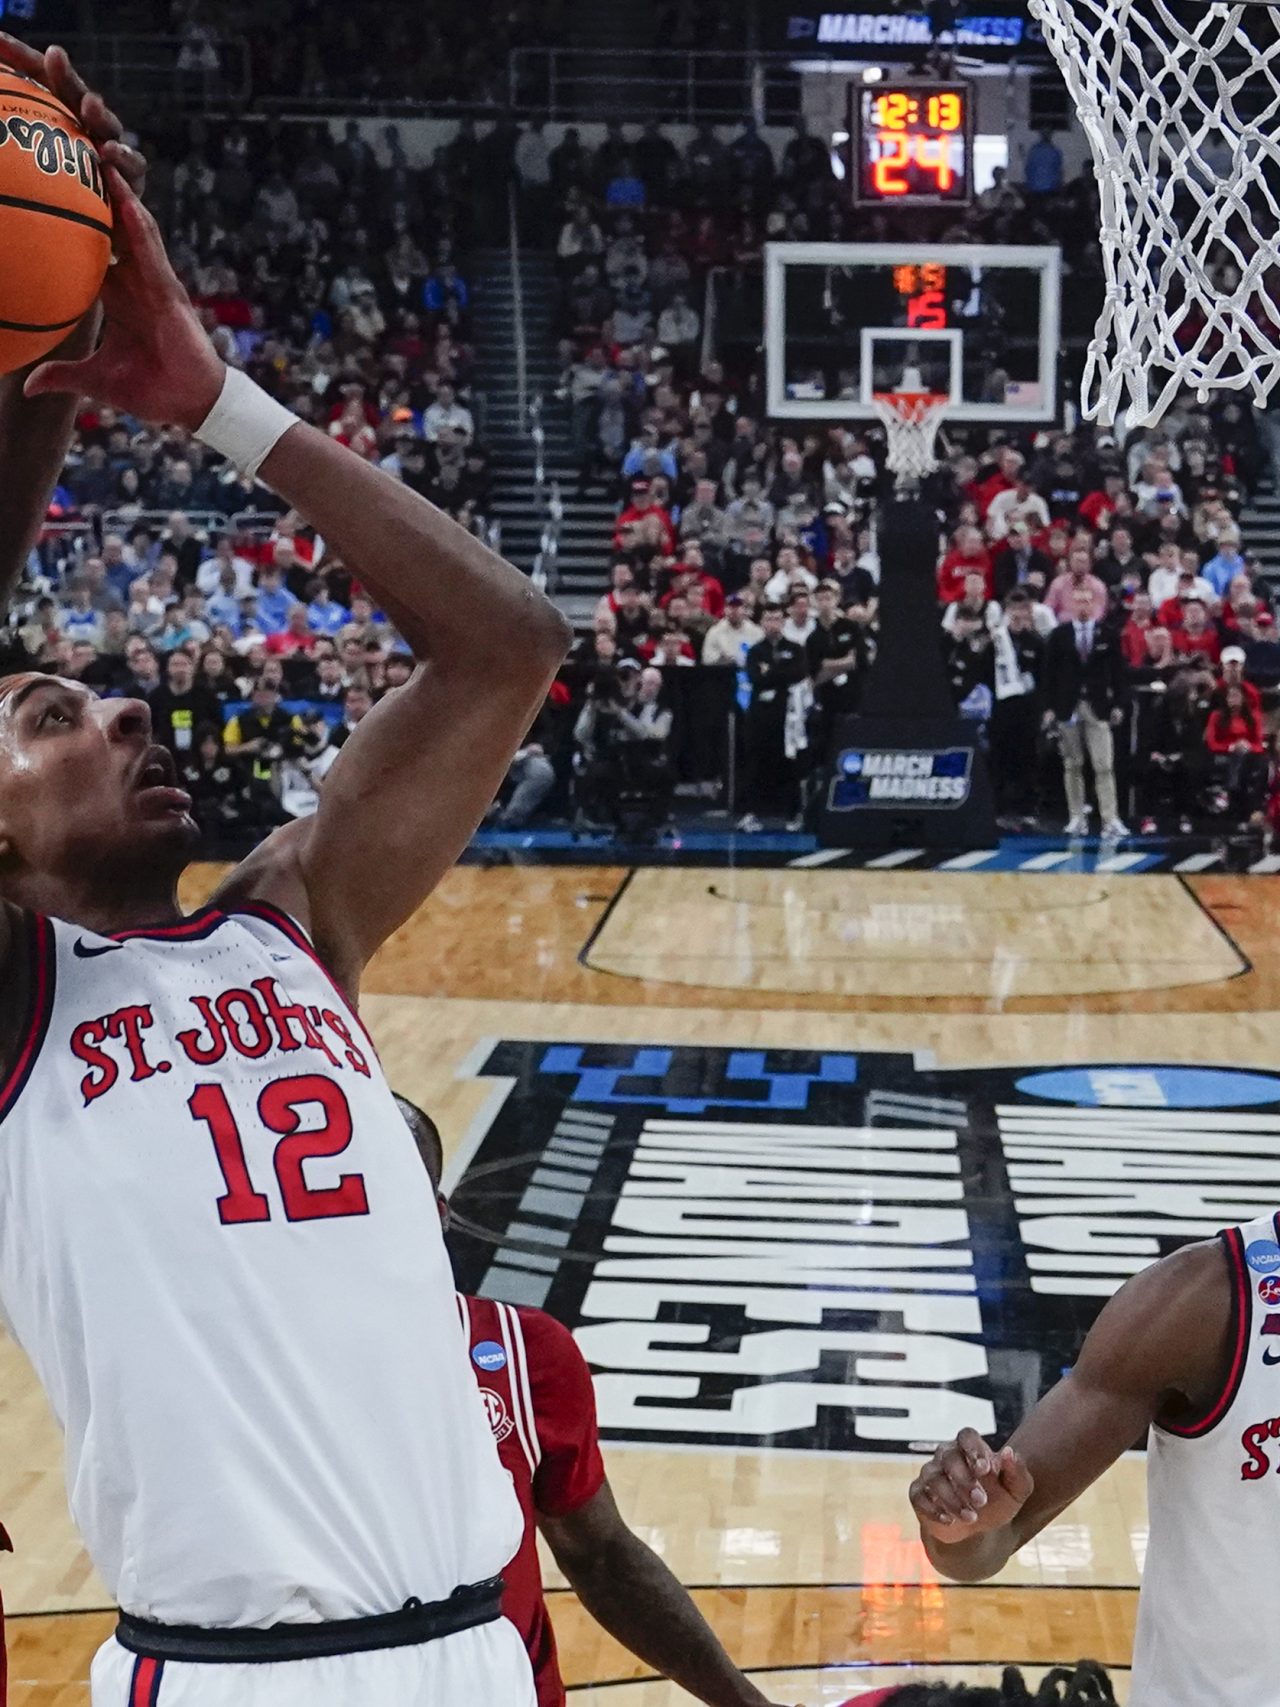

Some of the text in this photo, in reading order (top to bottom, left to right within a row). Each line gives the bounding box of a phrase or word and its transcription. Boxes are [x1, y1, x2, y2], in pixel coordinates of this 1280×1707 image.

[877, 93, 960, 130] 12:13
[874, 132, 952, 193] 24
[860, 753, 934, 777] MARCH
[868, 776, 966, 800] MADNESS
[70, 1003, 172, 1109] ST.
[186, 1073, 370, 1226] 12
[572, 1117, 998, 1441] MADNESS
[478, 1352, 505, 1364] NCAA
